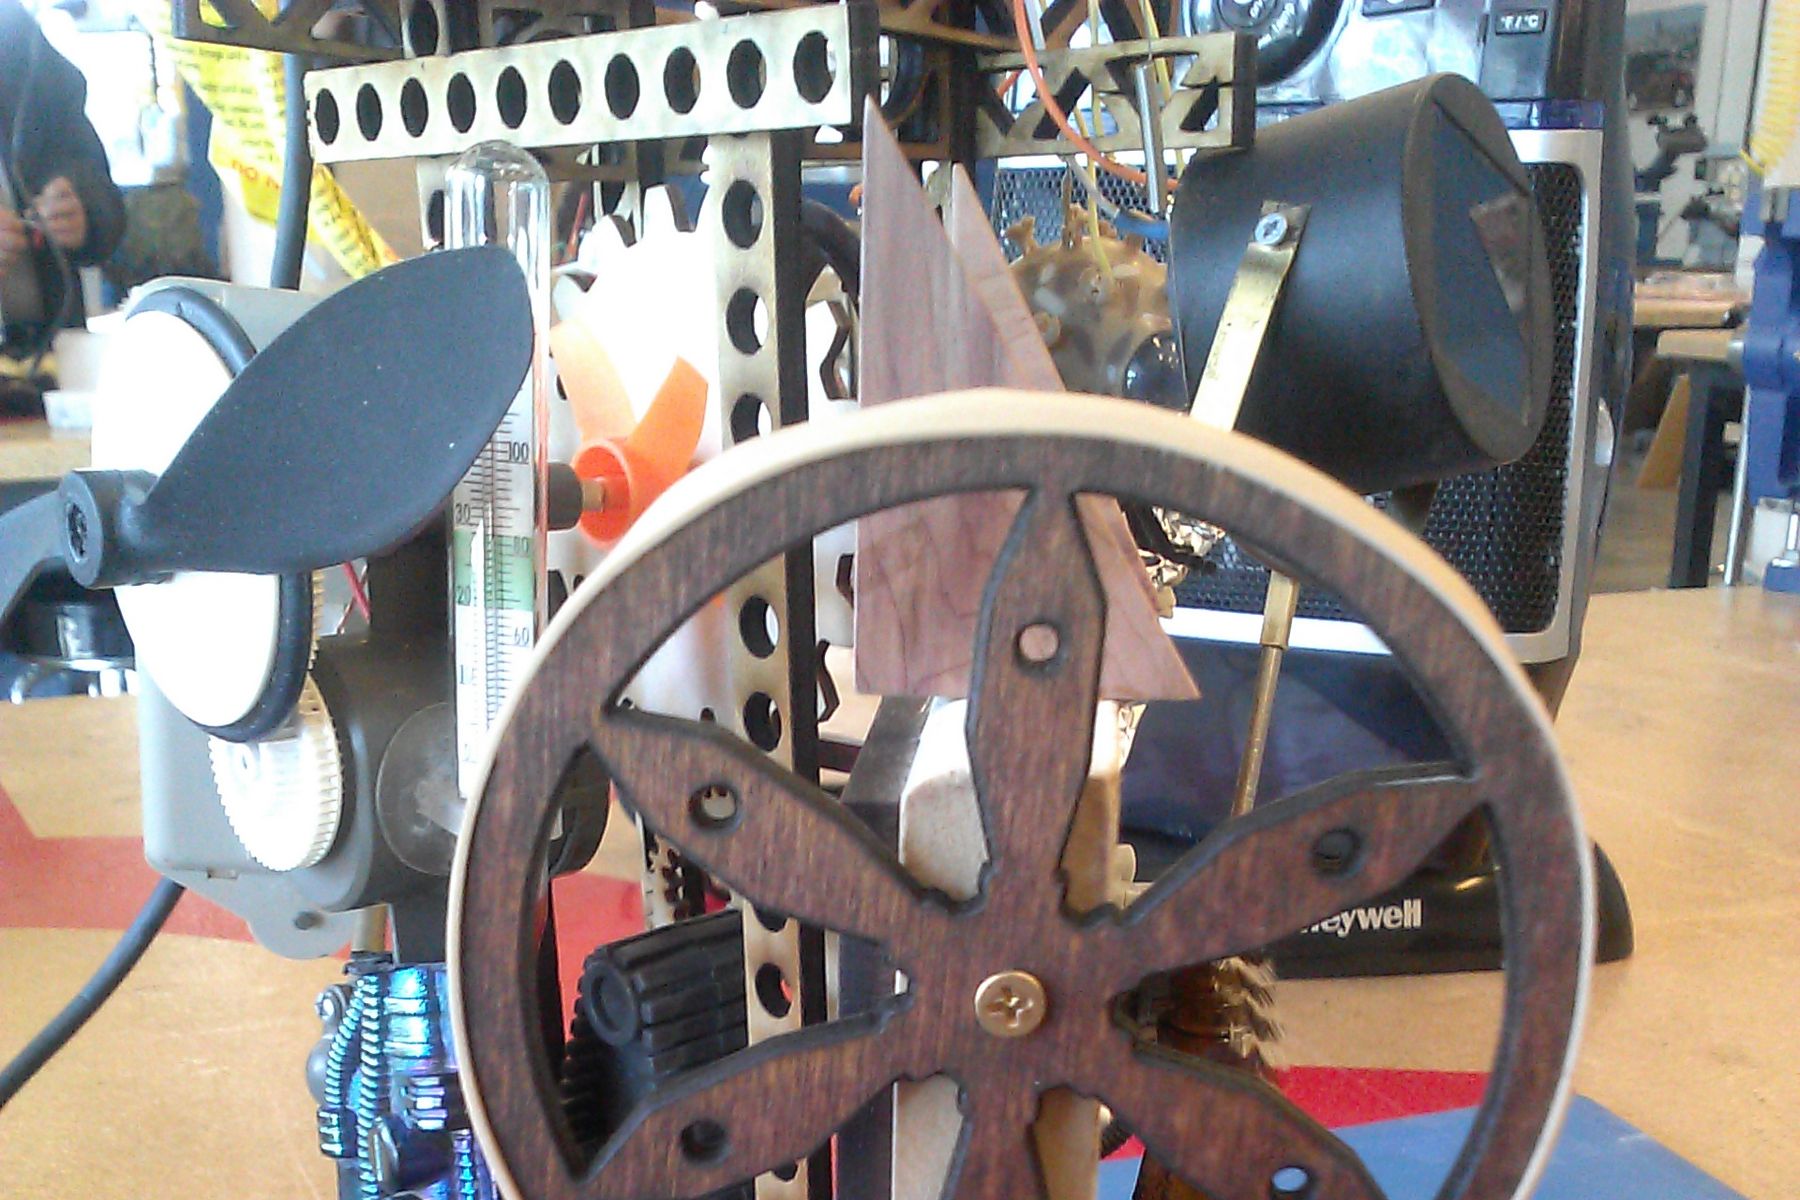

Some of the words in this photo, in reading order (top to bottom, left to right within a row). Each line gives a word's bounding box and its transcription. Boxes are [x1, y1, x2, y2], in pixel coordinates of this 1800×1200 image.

[508, 440, 530, 463] 100
[455, 503, 472, 525] 30
[513, 626, 530, 647] 60
[1300, 898, 1422, 938] eywell
